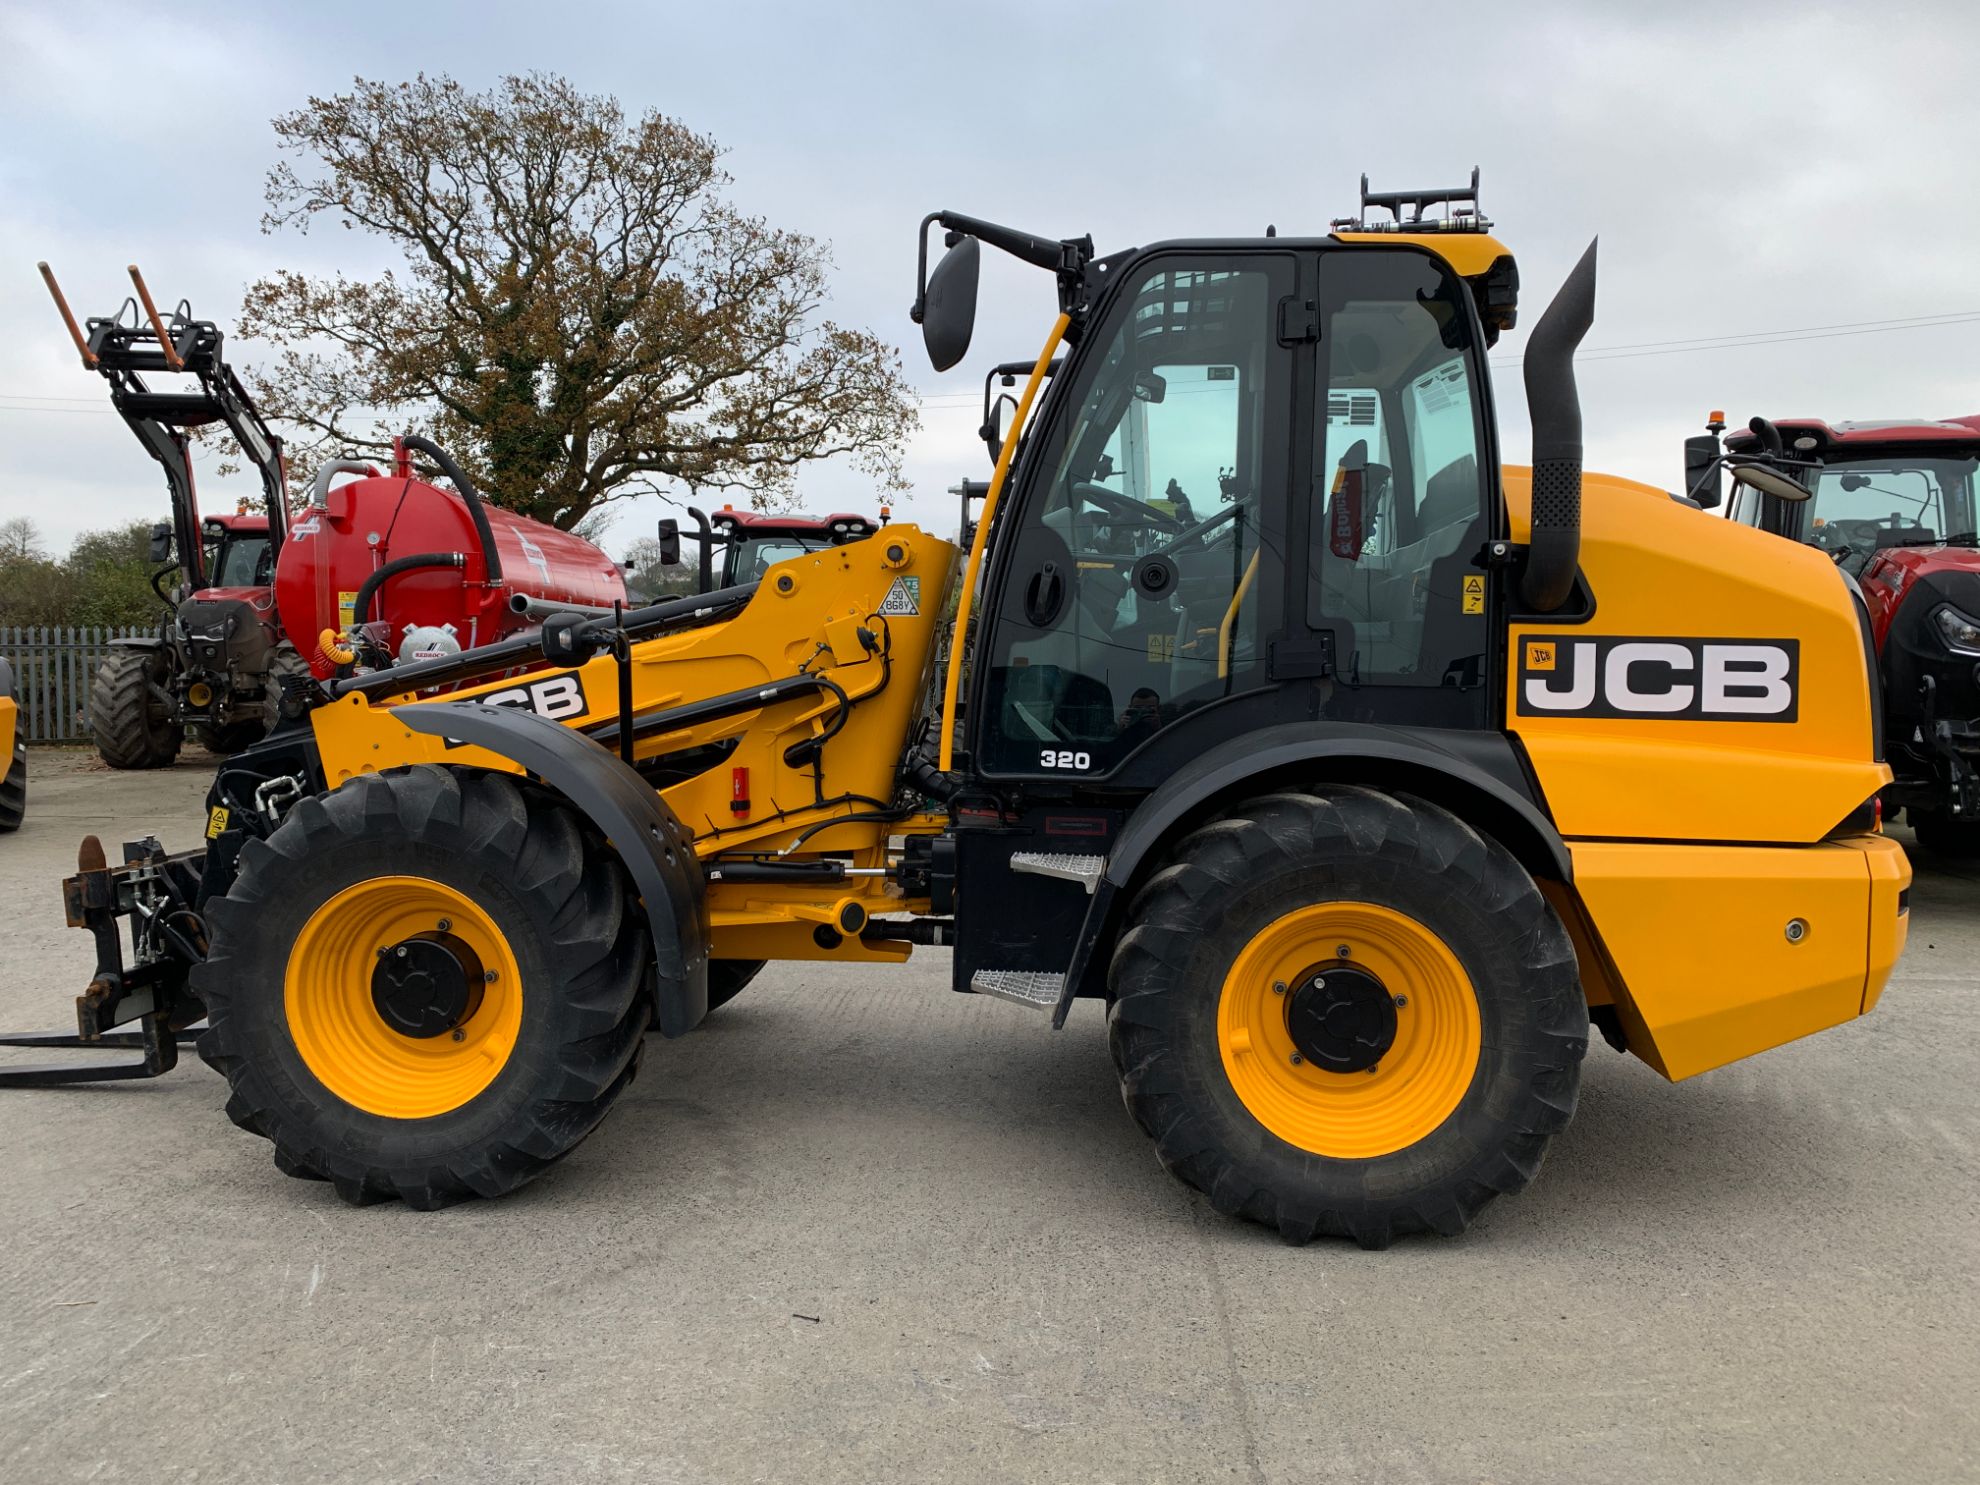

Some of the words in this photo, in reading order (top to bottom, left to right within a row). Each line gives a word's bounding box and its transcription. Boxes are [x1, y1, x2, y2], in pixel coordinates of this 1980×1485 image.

[1534, 649, 1551, 663] JCB
[1525, 642, 1791, 714] JCB
[1040, 750, 1090, 769] 320
